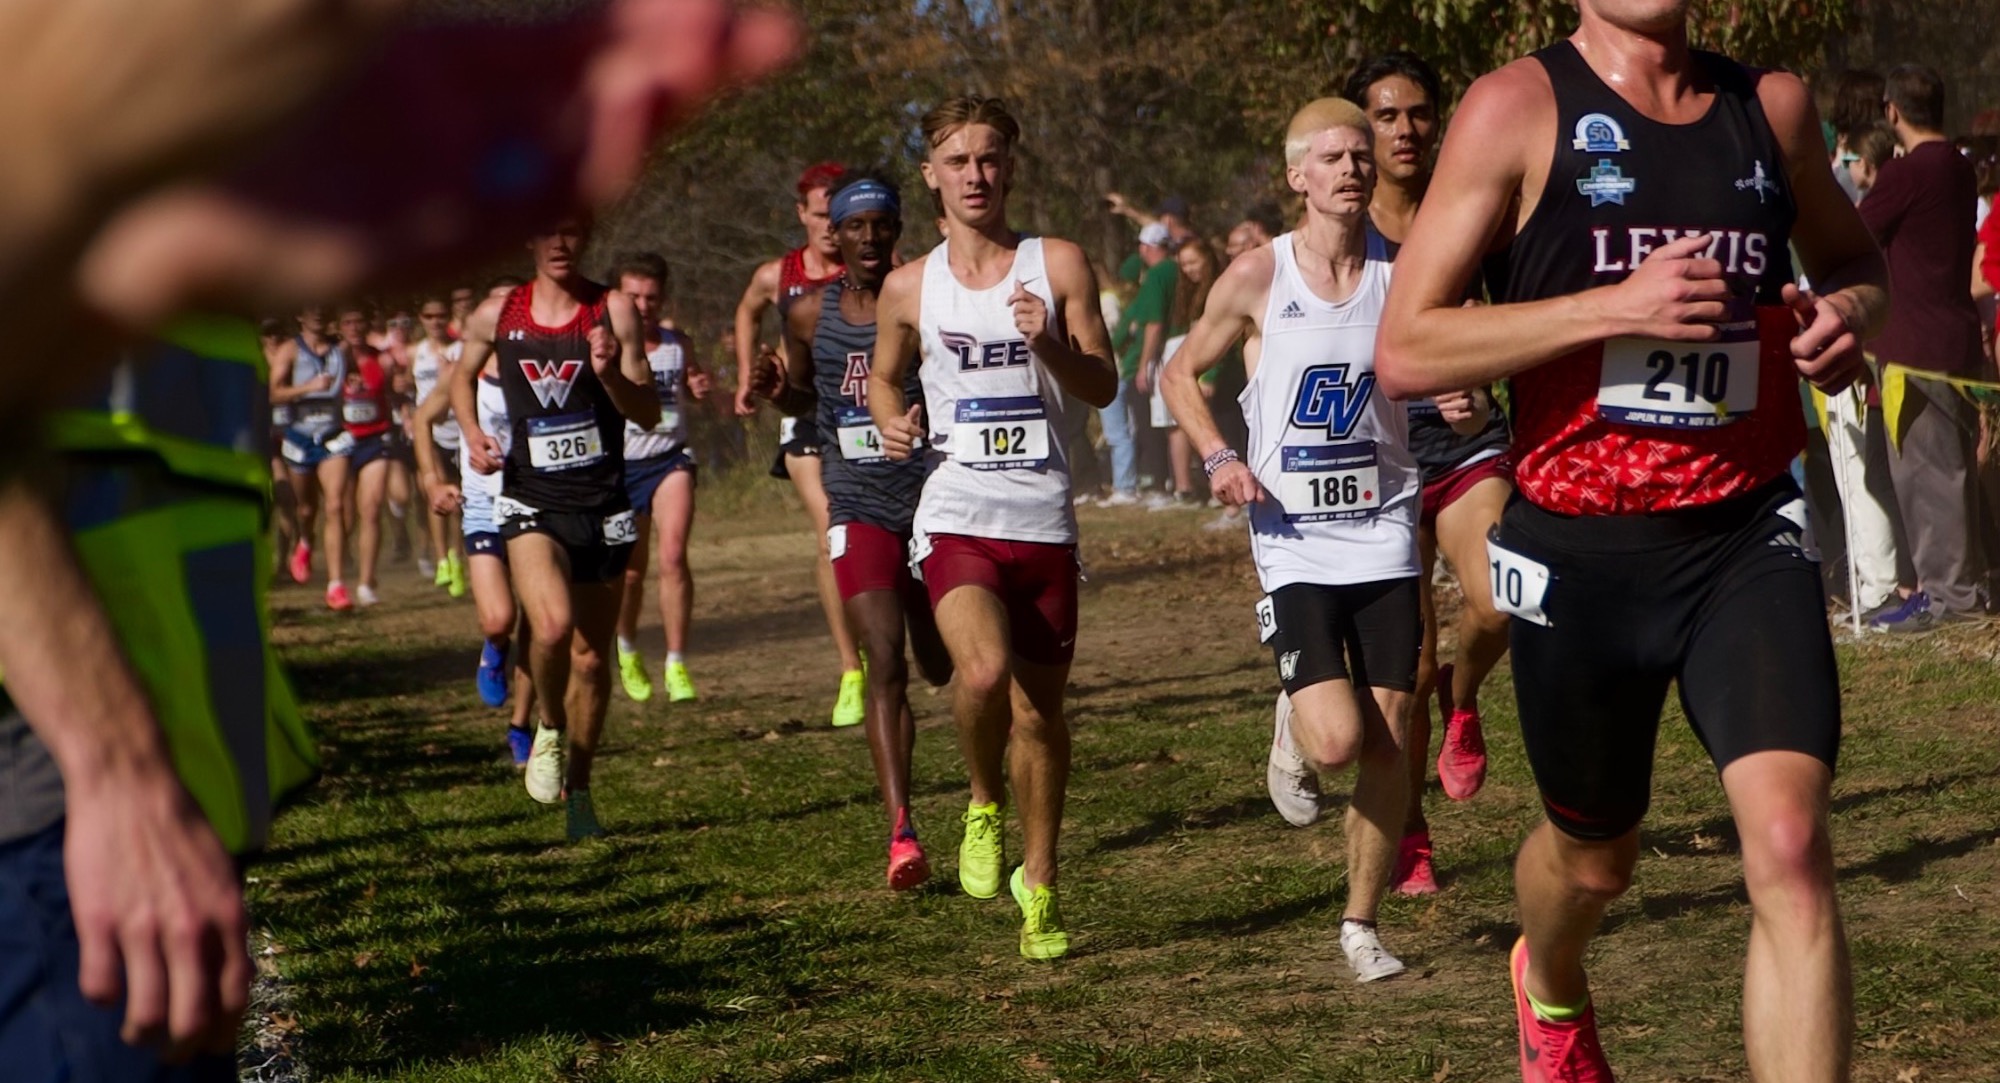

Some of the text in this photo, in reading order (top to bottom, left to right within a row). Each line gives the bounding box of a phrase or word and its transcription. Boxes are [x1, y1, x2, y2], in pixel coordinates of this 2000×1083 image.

[1589, 127, 1612, 142] 50
[959, 338, 1030, 373] LEE
[518, 359, 584, 409] W
[1642, 350, 1730, 404] 210
[1290, 363, 1376, 441] GV
[547, 436, 587, 460] 326
[979, 426, 1026, 456] 192
[1308, 475, 1358, 507] 186
[1491, 559, 1522, 608] 10
